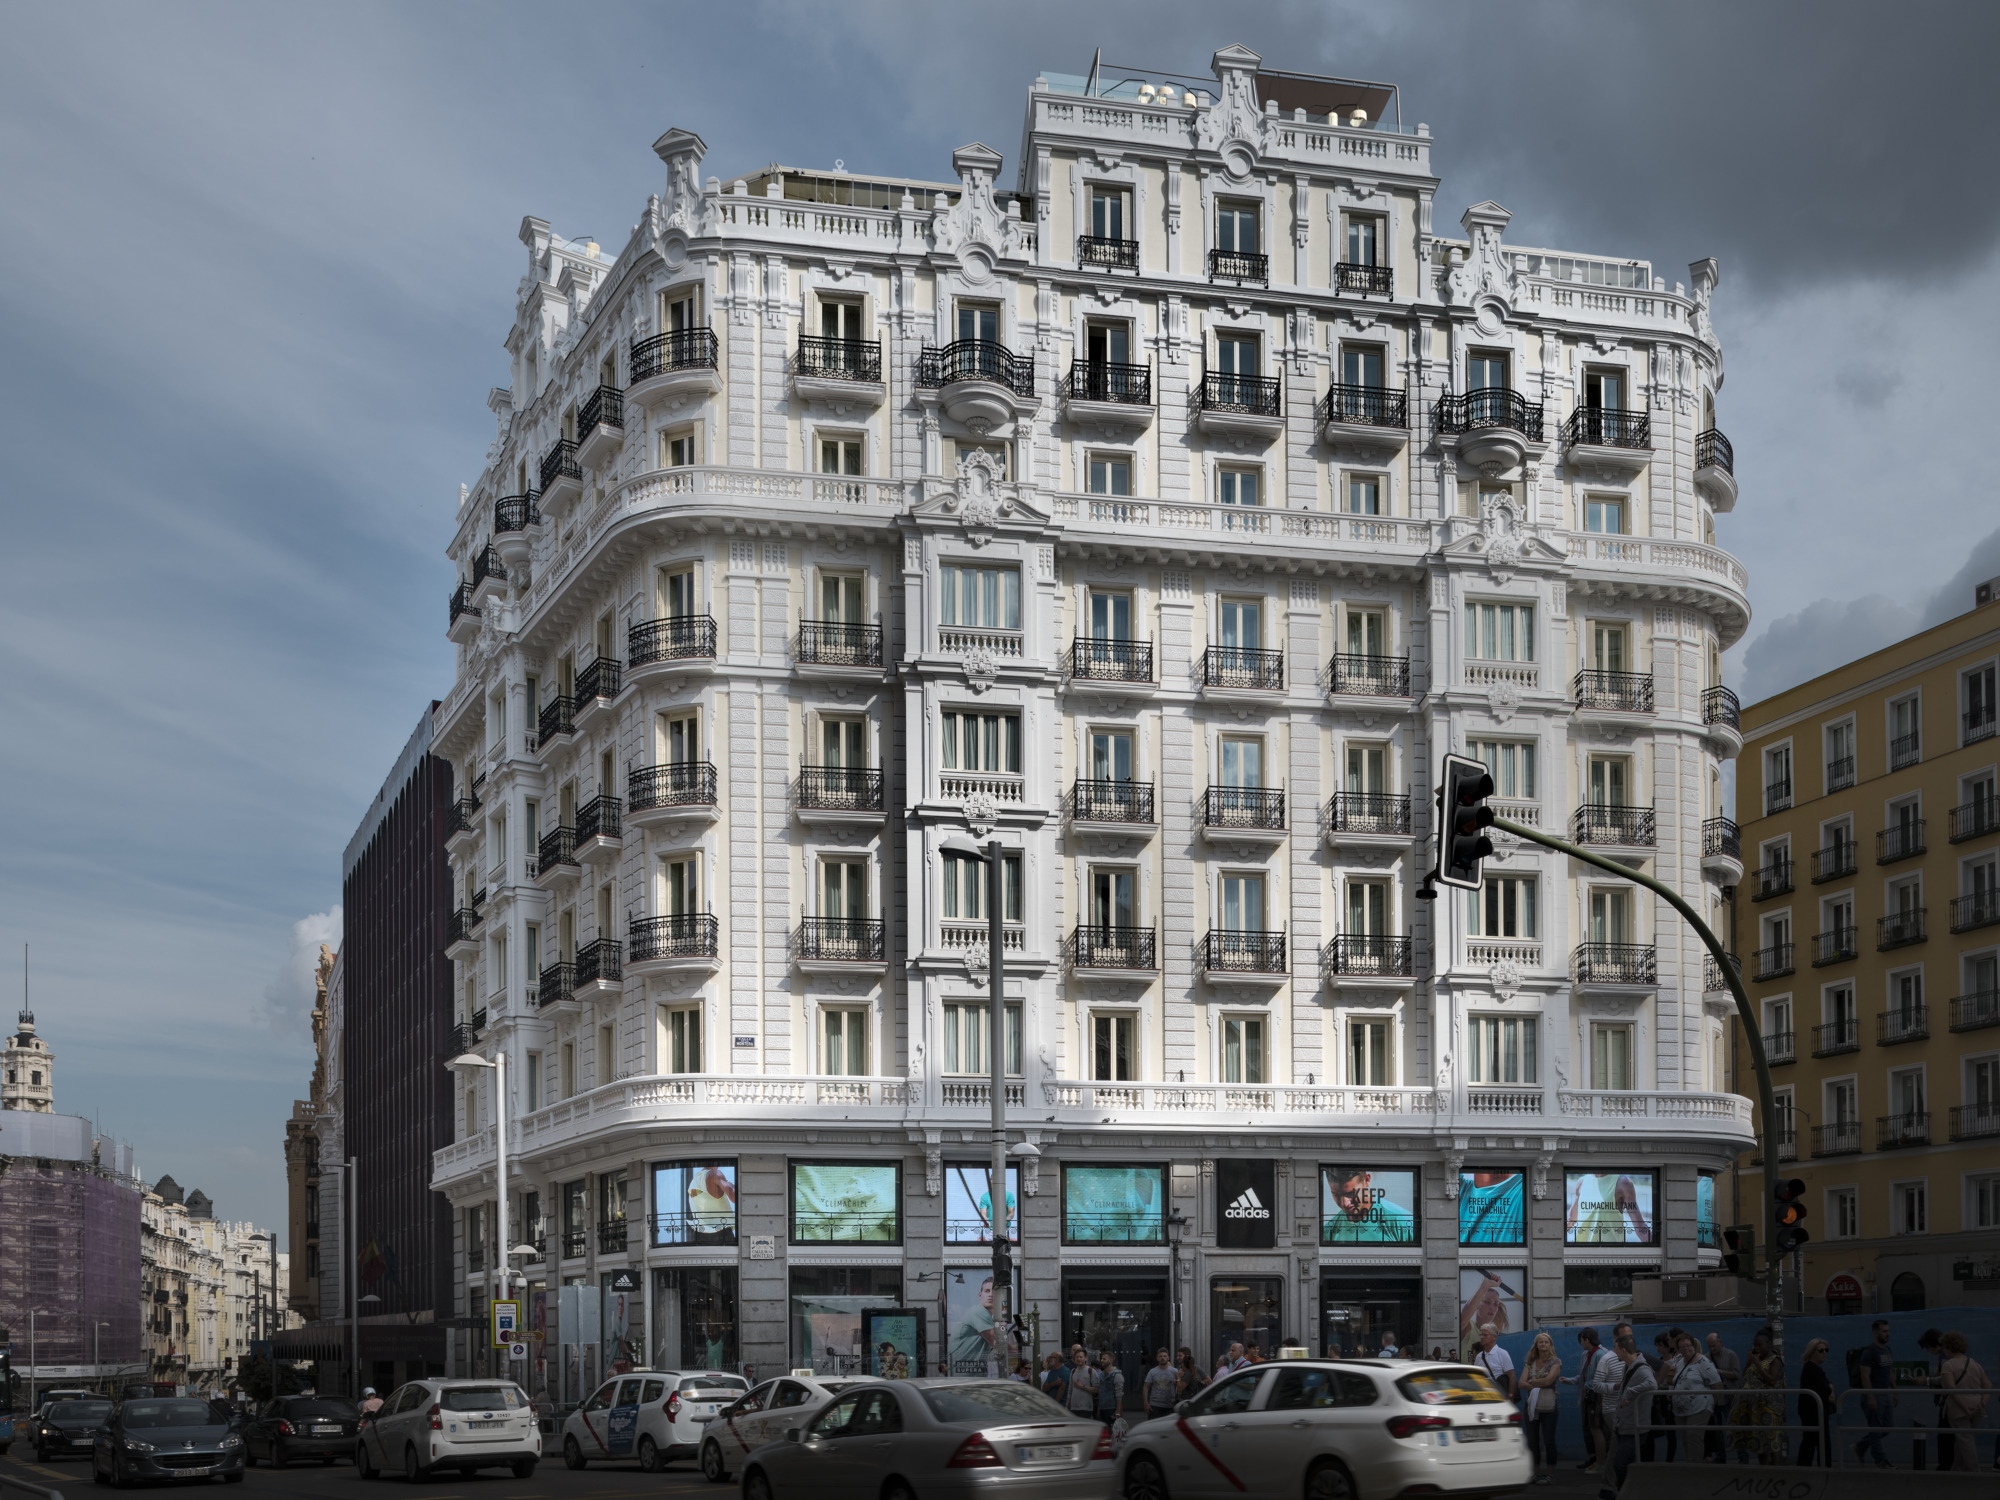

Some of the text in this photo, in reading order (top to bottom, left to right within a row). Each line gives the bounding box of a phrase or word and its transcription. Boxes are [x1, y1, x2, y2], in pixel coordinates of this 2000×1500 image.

[1352, 1187, 1385, 1204] KEEP
[1468, 1206, 1507, 1214] CLIMACHILL
[1580, 1201, 1619, 1210] CLIMACHILL
[1225, 1207, 1269, 1218] adidas
[1352, 1208, 1386, 1223] COOL
